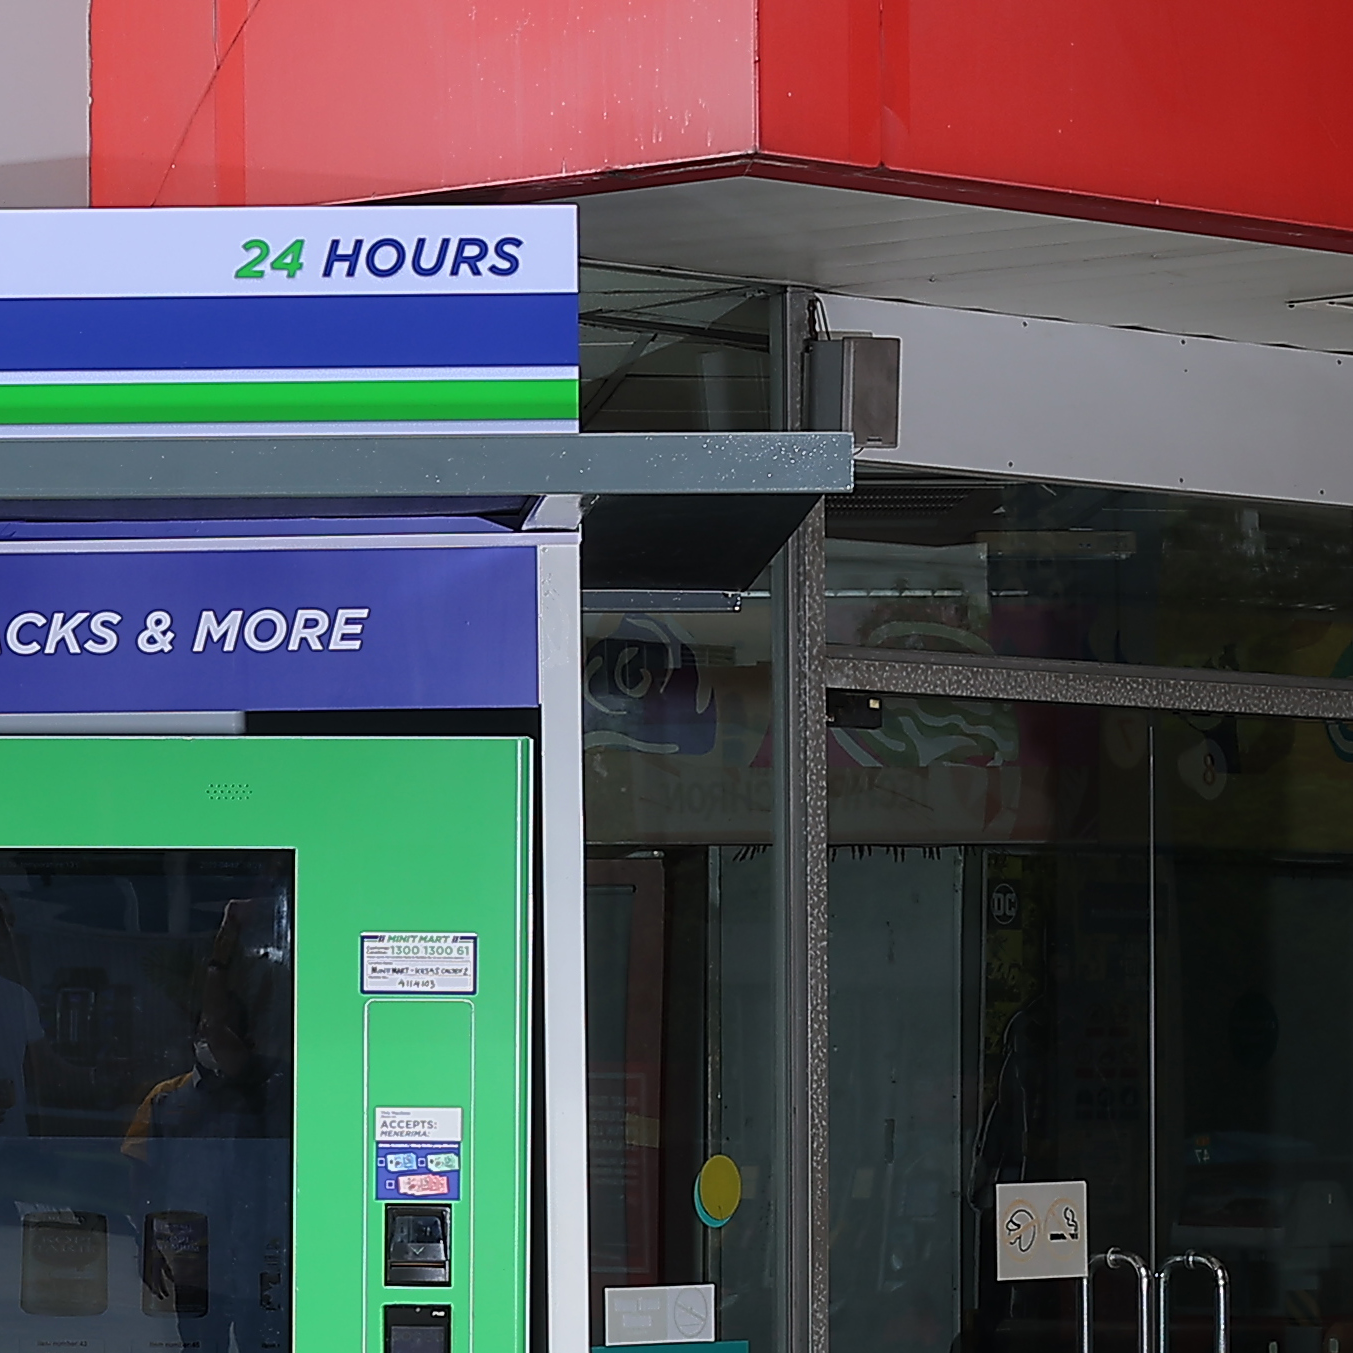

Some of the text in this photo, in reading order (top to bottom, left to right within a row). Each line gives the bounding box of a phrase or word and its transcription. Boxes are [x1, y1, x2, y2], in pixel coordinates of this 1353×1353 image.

[234, 236, 525, 278] 24 HOURS
[136, 609, 174, 653] &
[191, 607, 371, 652] MORE
[418, 935, 450, 943] MART
[390, 946, 469, 955] 1300 1300 61
[380, 1120, 437, 1130] ACCEPTS:
[380, 1130, 431, 1138] MENERIMA:
